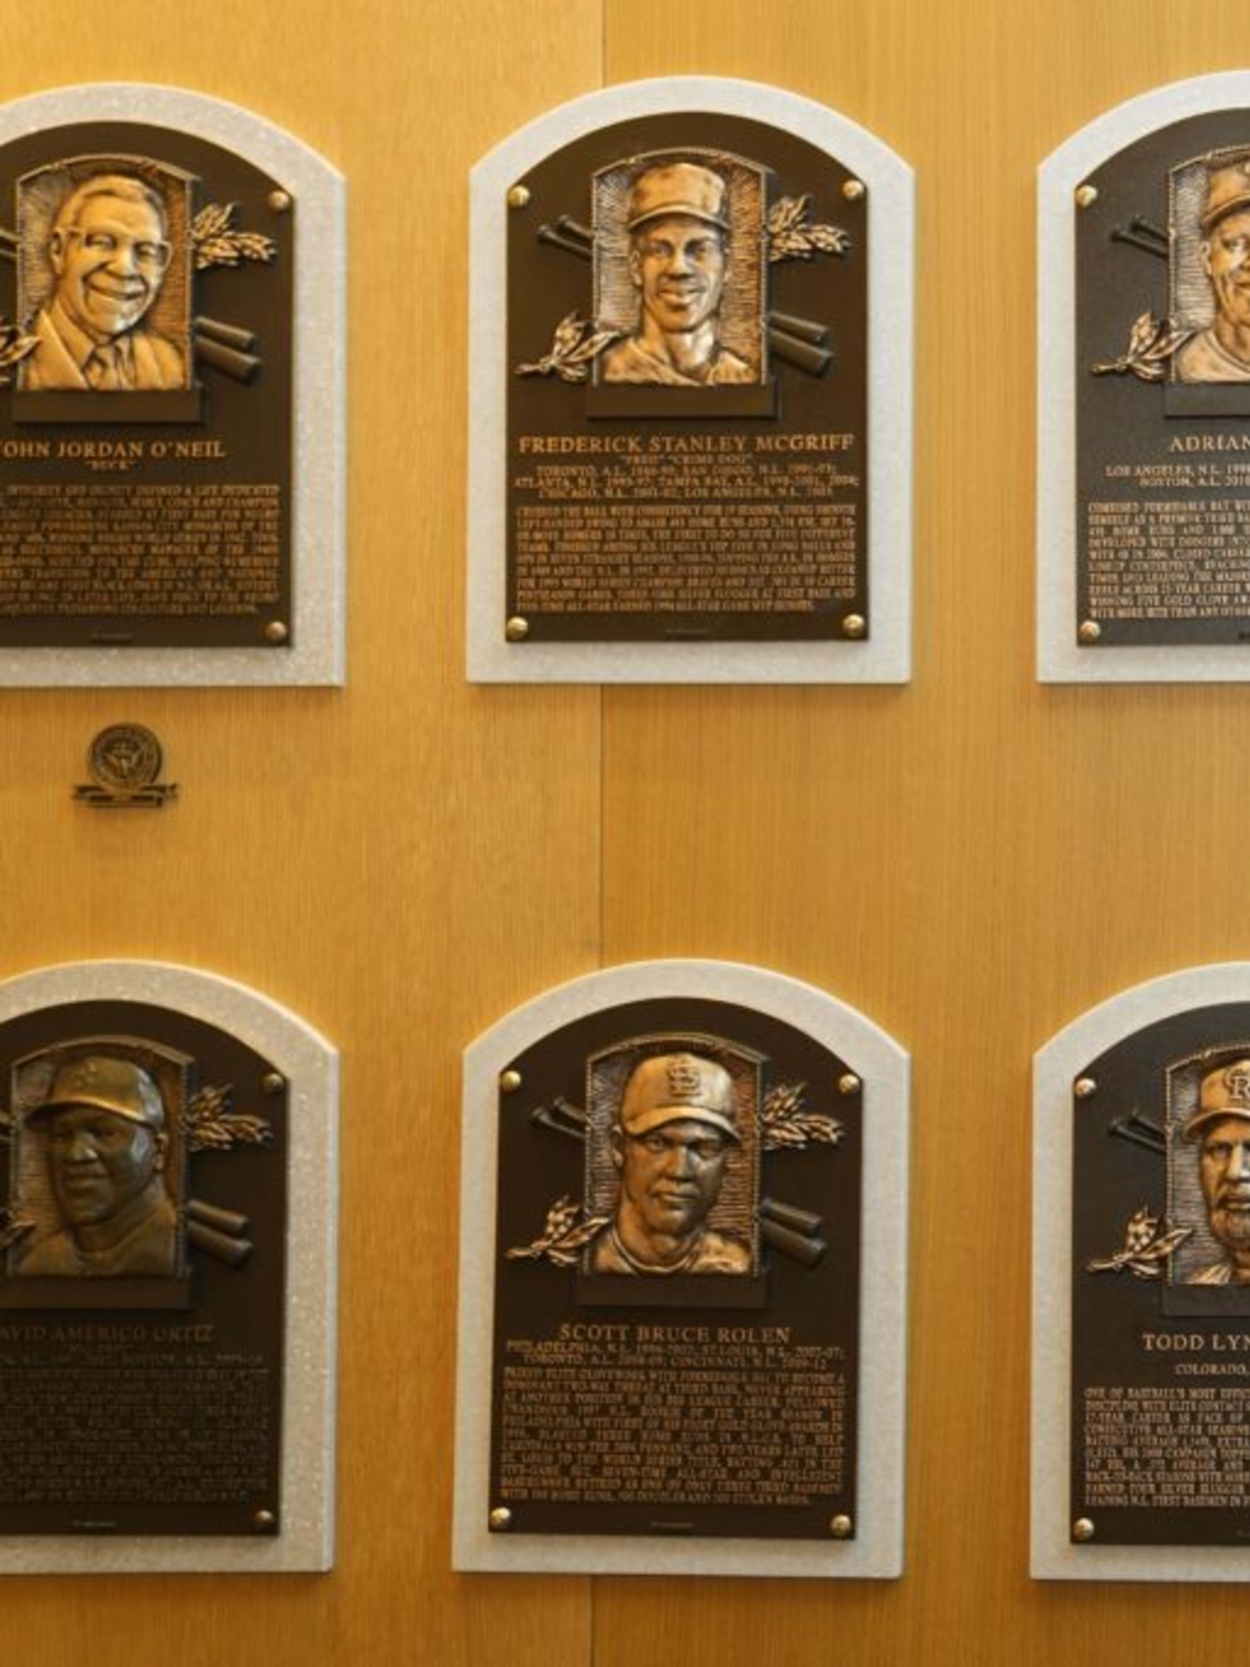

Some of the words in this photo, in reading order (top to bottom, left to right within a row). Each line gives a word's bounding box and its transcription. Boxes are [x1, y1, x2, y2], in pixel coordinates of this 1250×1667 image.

[58, 441, 143, 458] JORDAN
[151, 440, 227, 458] O'NEIL
[519, 436, 643, 453] FREDERICK
[649, 436, 746, 453] STANLEY
[756, 434, 855, 451] MCGRIFF
[1105, 464, 1130, 477] LOS
[0, 1326, 46, 1342] AVID
[560, 1324, 630, 1341] SCOTT
[638, 1326, 710, 1343] BRUCE
[717, 1327, 791, 1343] ROLEN
[1142, 1333, 1205, 1351] TODD
[1175, 1363, 1250, 1377] COLORADO,
